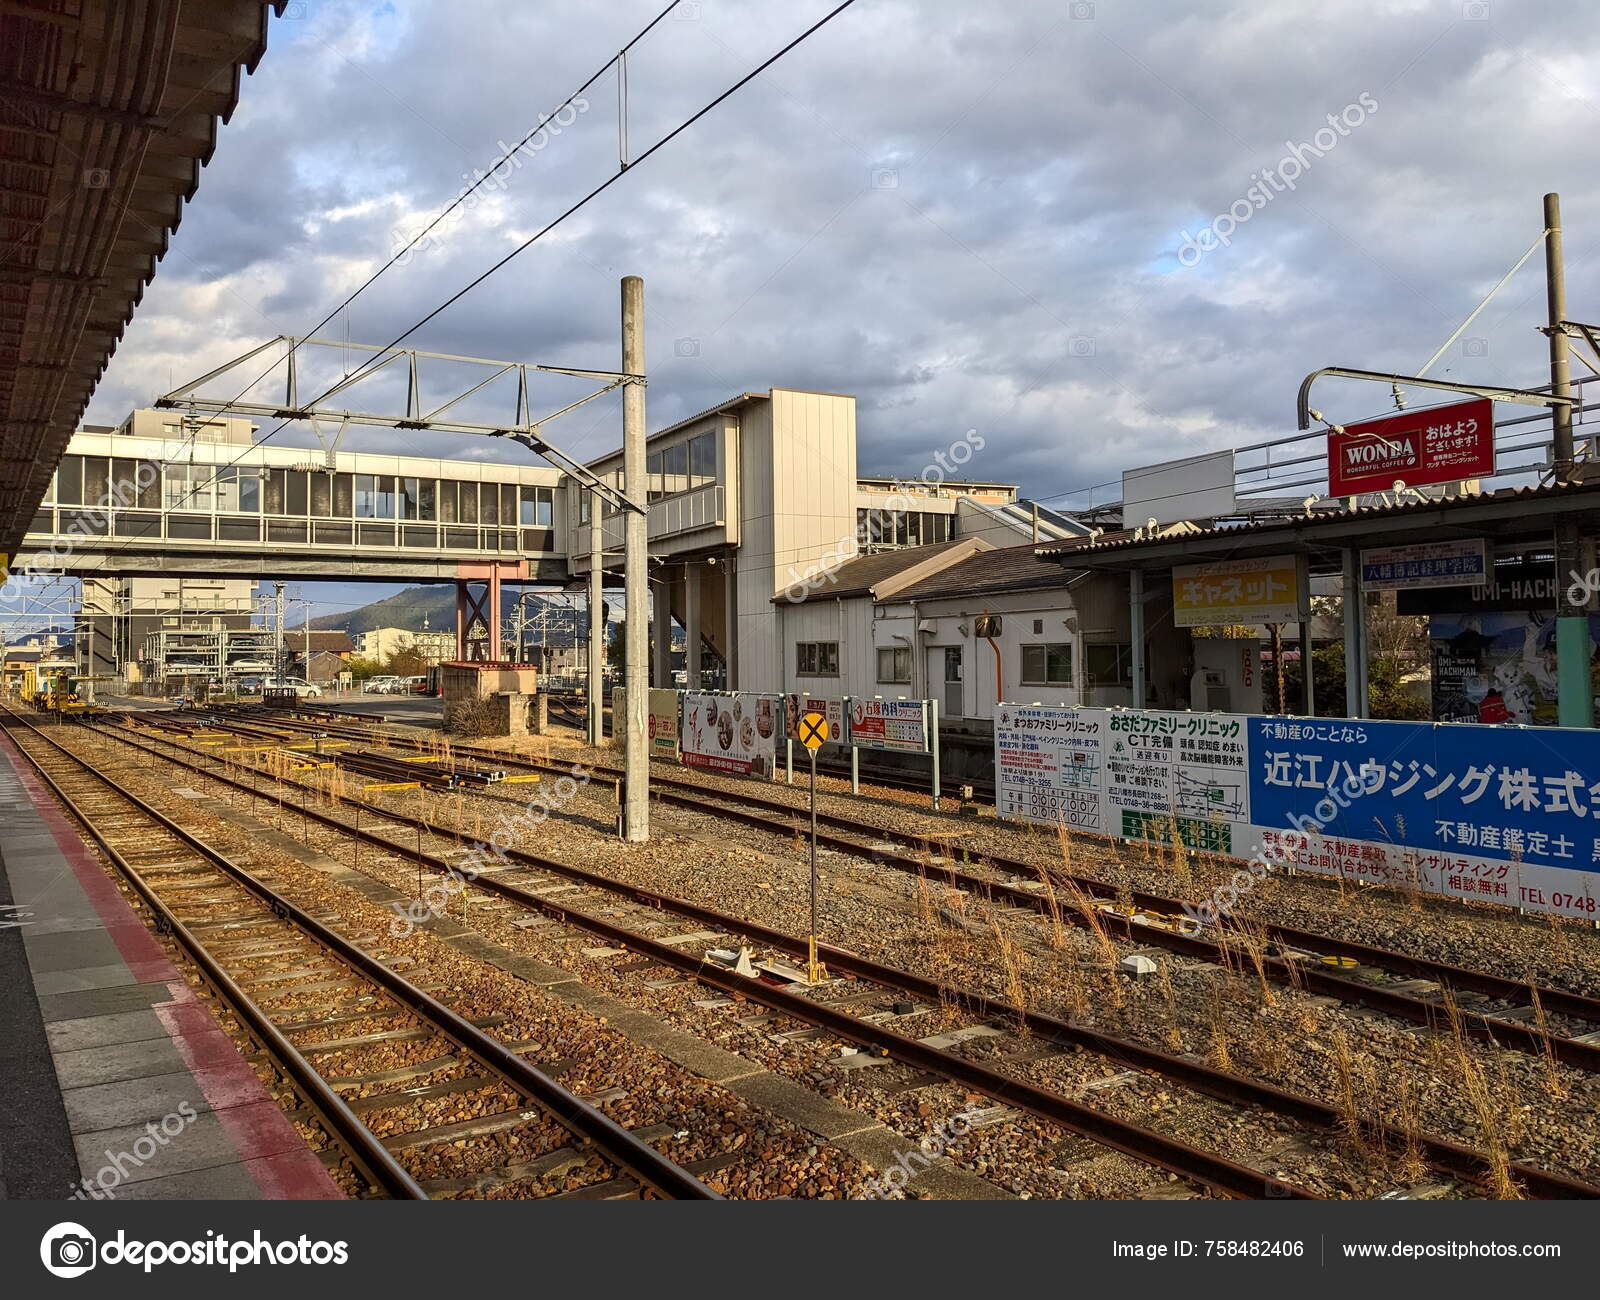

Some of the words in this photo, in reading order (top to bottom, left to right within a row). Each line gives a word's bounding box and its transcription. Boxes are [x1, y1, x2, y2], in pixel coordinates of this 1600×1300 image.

[1425, 418, 1478, 440] おはよう
[1346, 438, 1414, 464] WONDA
[1346, 463, 1380, 474] WONDERFUL
[1381, 459, 1404, 469] COFFEE
[1183, 574, 1287, 604] キャネット
[1014, 718, 1099, 734] まつおファミリークリニック
[1110, 714, 1240, 738] おさだファミリークリニック
[1261, 722, 1368, 744] 不動産のことなら
[1127, 734, 1173, 748] CT完備
[1222, 741, 1244, 753] めまい
[1263, 750, 1600, 819] 近江ハウジング株式
[1435, 819, 1574, 858] 不動産鑑定士
[1448, 875, 1508, 898] 相談無料
[1519, 887, 1546, 905] TEL
